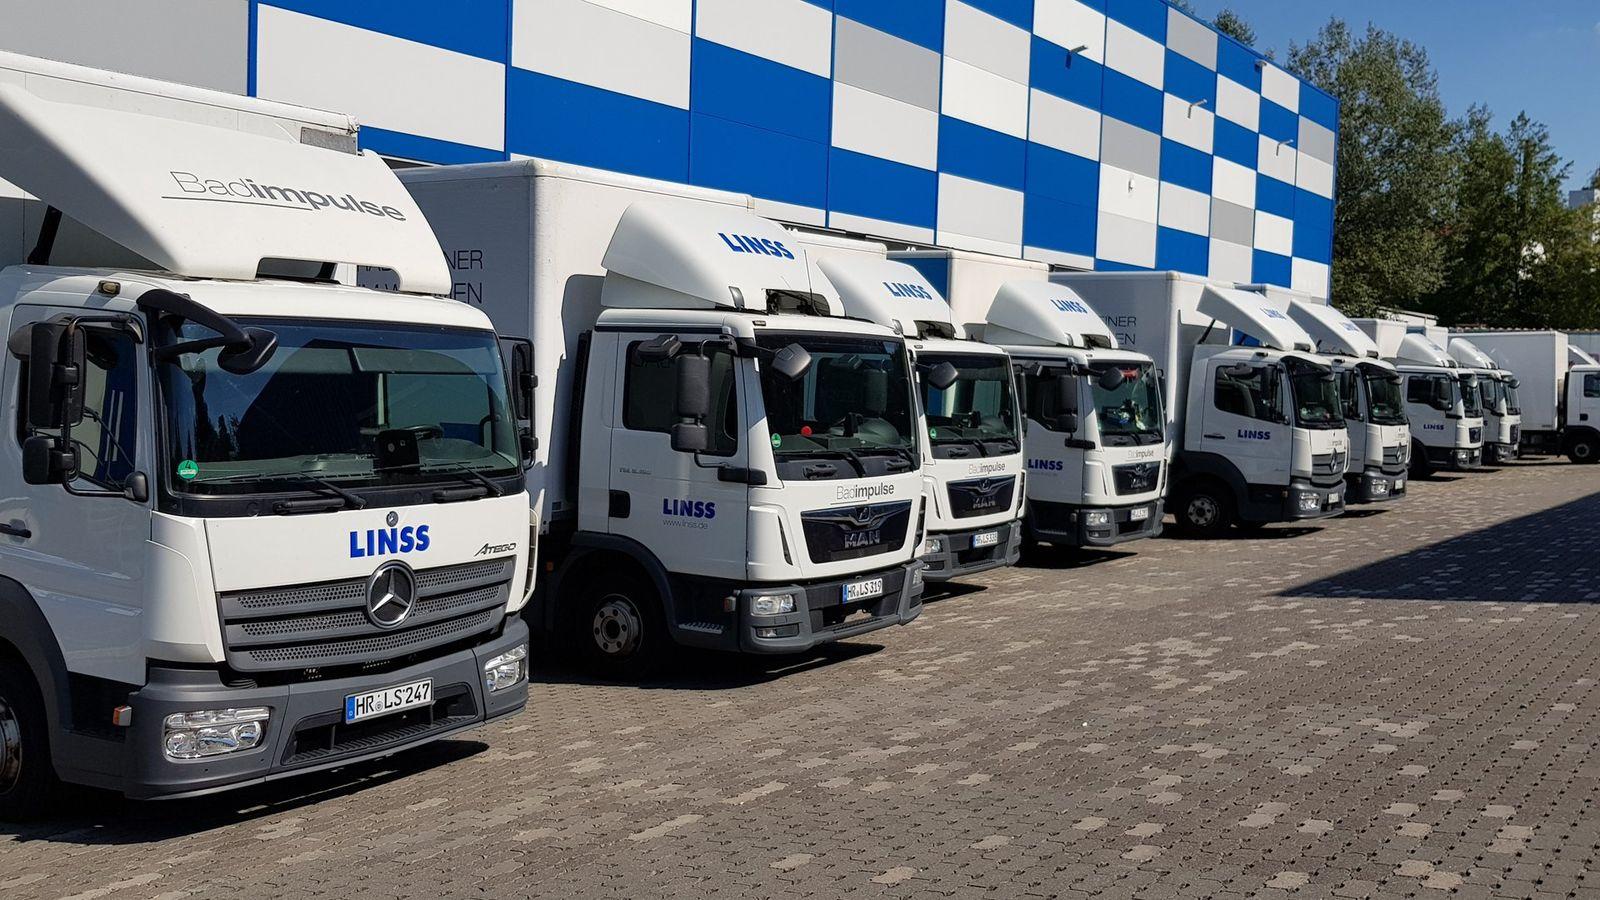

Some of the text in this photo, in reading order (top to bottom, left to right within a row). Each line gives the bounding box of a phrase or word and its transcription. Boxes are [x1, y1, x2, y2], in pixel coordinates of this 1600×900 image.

[170, 171, 406, 221] Badimpulse
[718, 232, 795, 260] LINSS
[882, 281, 932, 300] LINSS
[1051, 299, 1088, 314] LINSS
[1237, 429, 1270, 440] LINSS
[1028, 459, 1063, 471] LINSS
[836, 482, 895, 499] Badimpulse
[663, 498, 715, 519] LINSS
[350, 524, 430, 558] LINSS
[844, 530, 880, 549] MAN
[474, 542, 517, 557] ATEGO
[356, 695, 374, 716] HR
